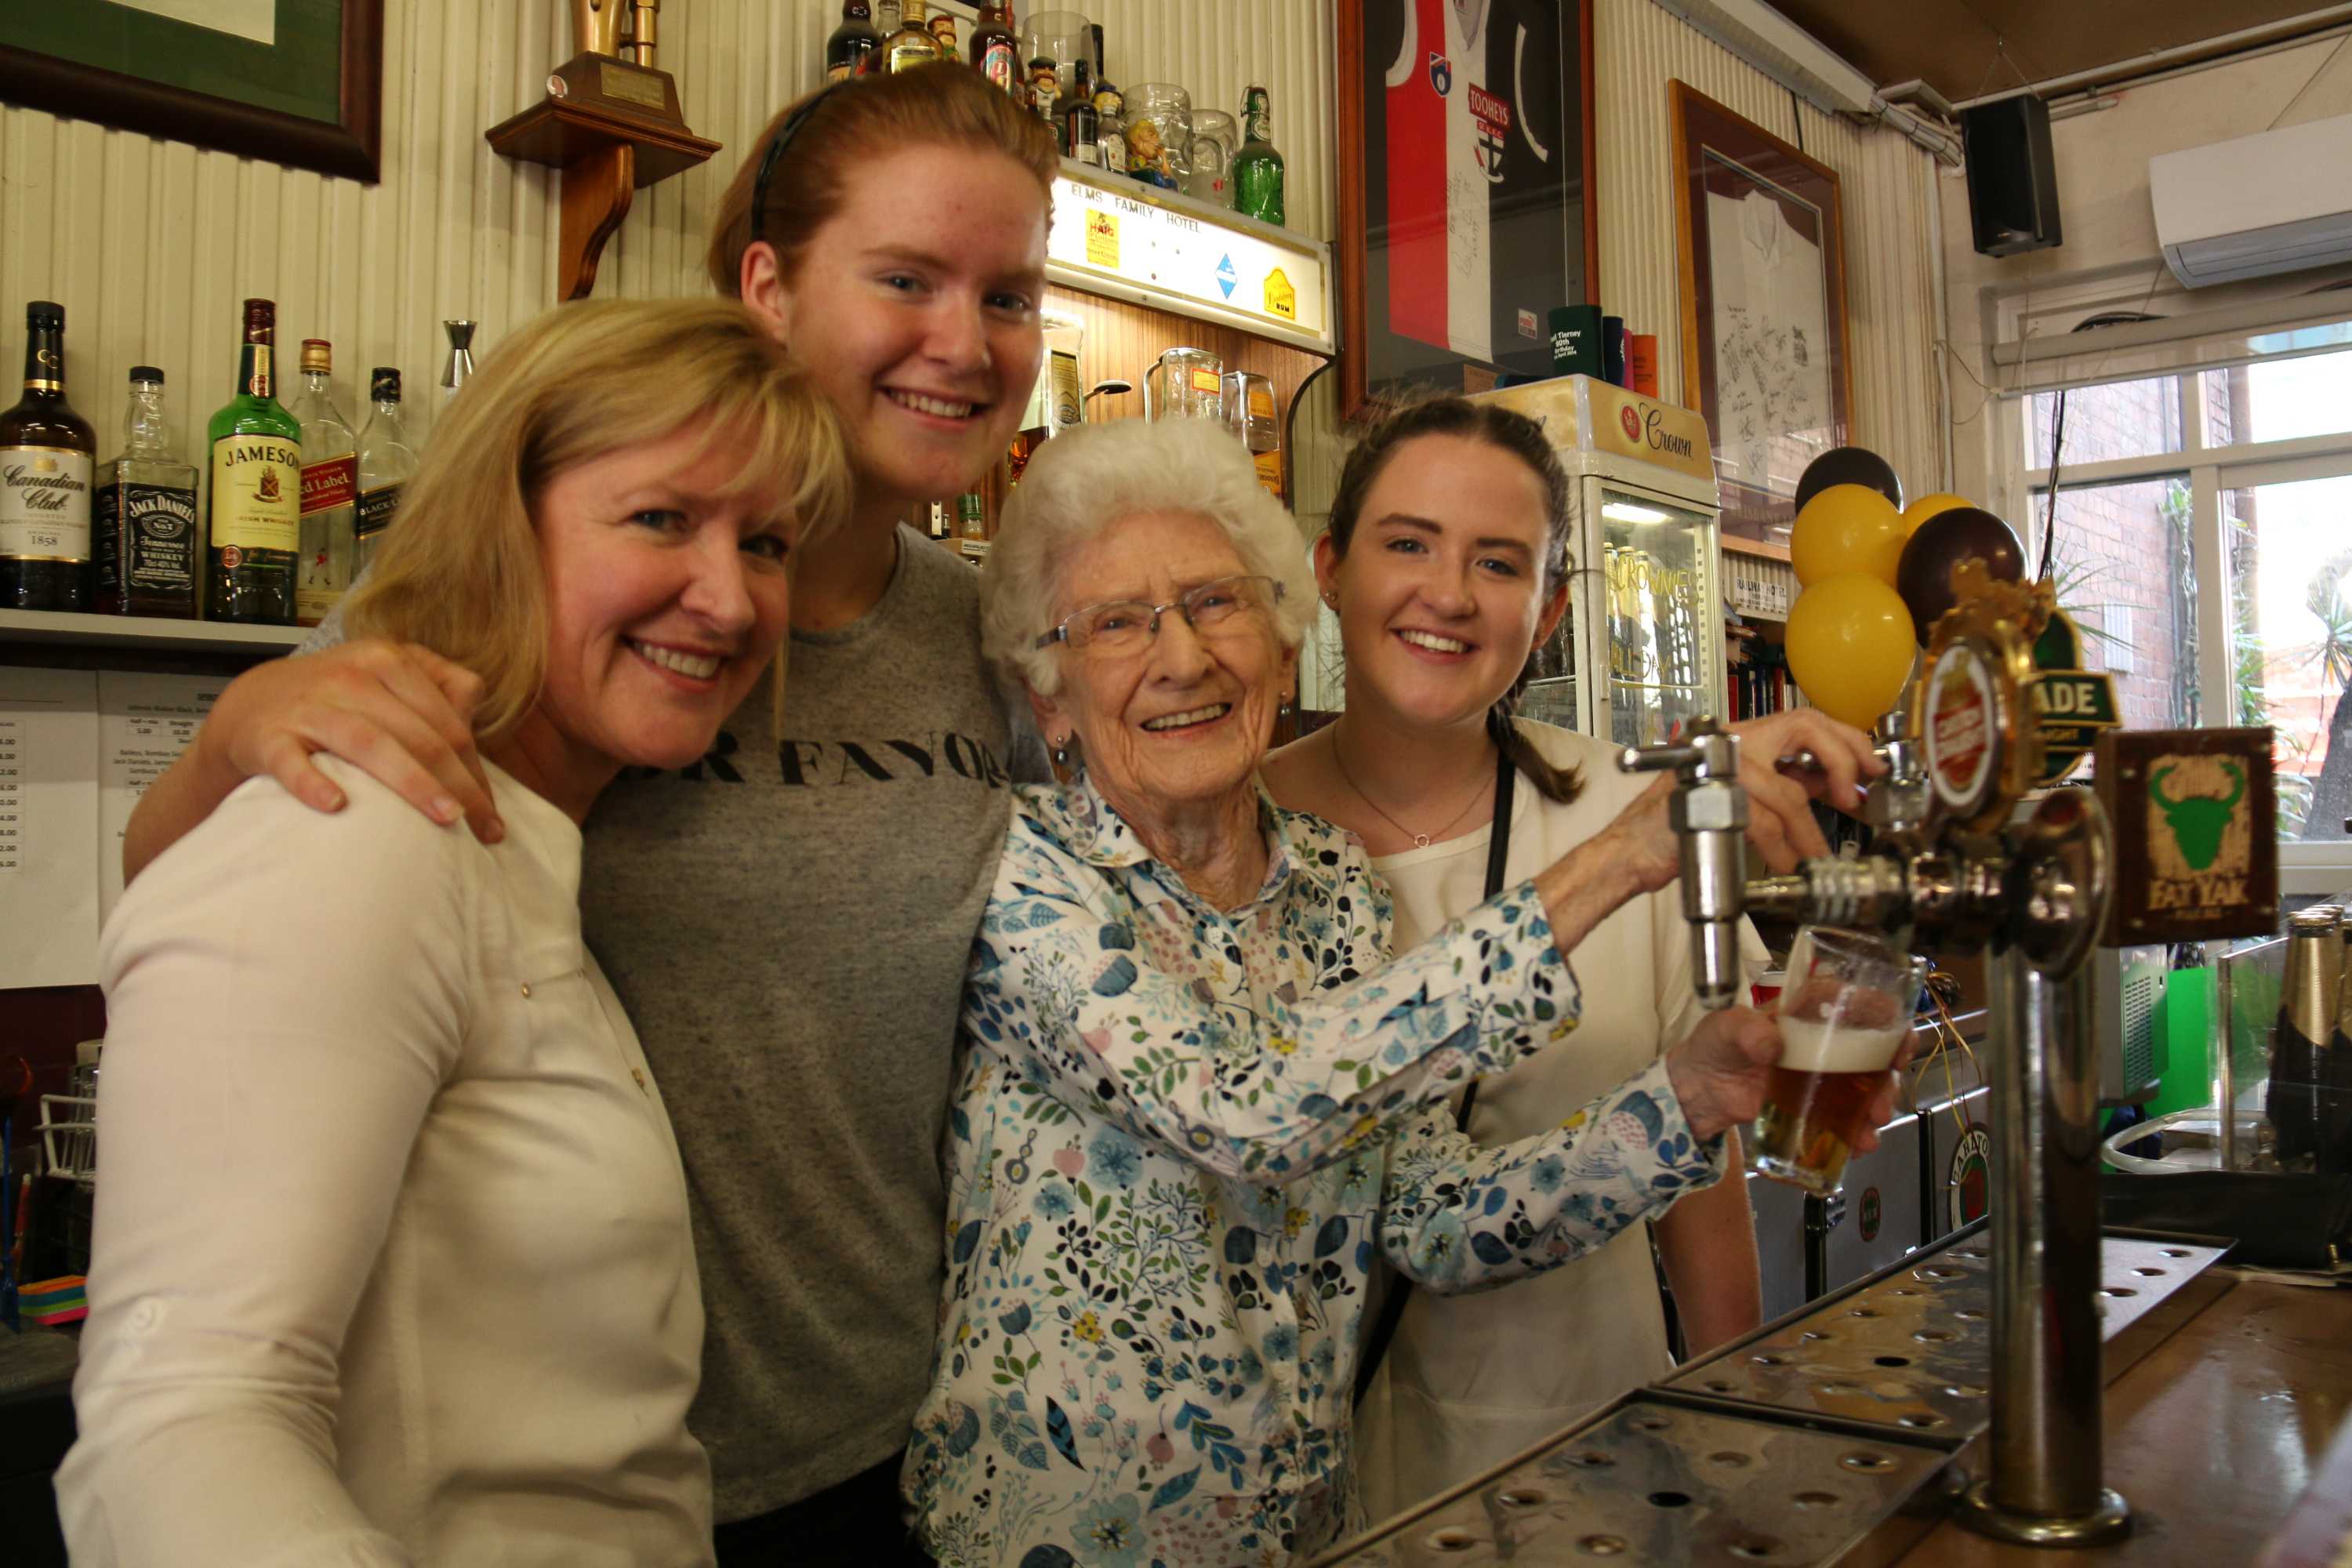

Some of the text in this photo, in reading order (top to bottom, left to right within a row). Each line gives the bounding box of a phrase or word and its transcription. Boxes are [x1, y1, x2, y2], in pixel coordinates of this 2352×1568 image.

[1470, 89, 1509, 125] TOOHEYS
[1071, 183, 1200, 233] ELMS FAMILY HOTEL
[1639, 402, 1692, 458] Crown
[3, 464, 85, 492] Canadian
[314, 472, 350, 491] Label
[21, 487, 70, 510] Club
[129, 498, 156, 517] JACK
[31, 535, 57, 546] 1858
[779, 730, 1010, 789] FAVOR
